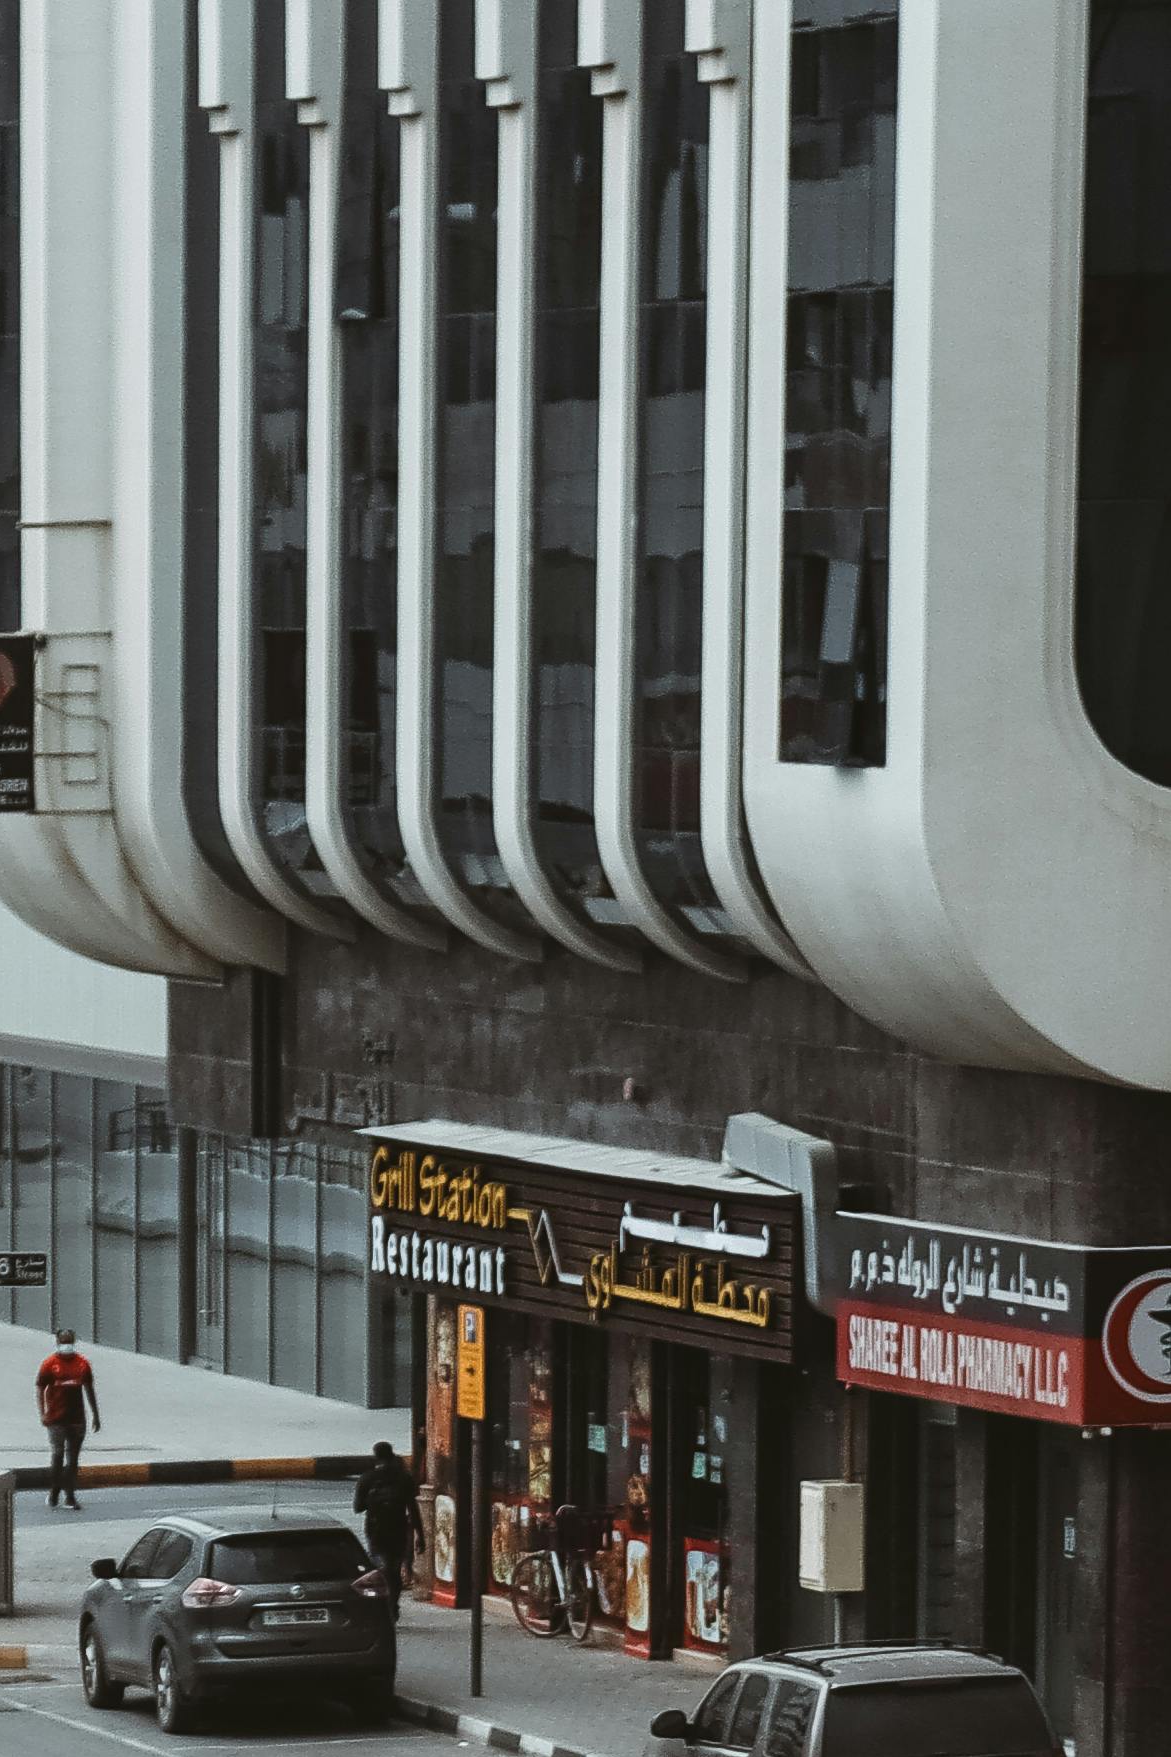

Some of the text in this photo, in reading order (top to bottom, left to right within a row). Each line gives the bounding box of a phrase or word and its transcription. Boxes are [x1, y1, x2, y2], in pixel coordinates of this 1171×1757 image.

[371, 1144, 508, 1229] Grill Station
[371, 1213, 505, 1295] Restaurant
[619, 1200, 770, 1258] مطعم
[942, 1241, 986, 1313] شارع
[988, 1247, 1070, 1322] صيدلية
[901, 1323, 917, 1379] AL
[920, 1327, 955, 1386] ROLA
[957, 1333, 1032, 1400] PHARMACY
